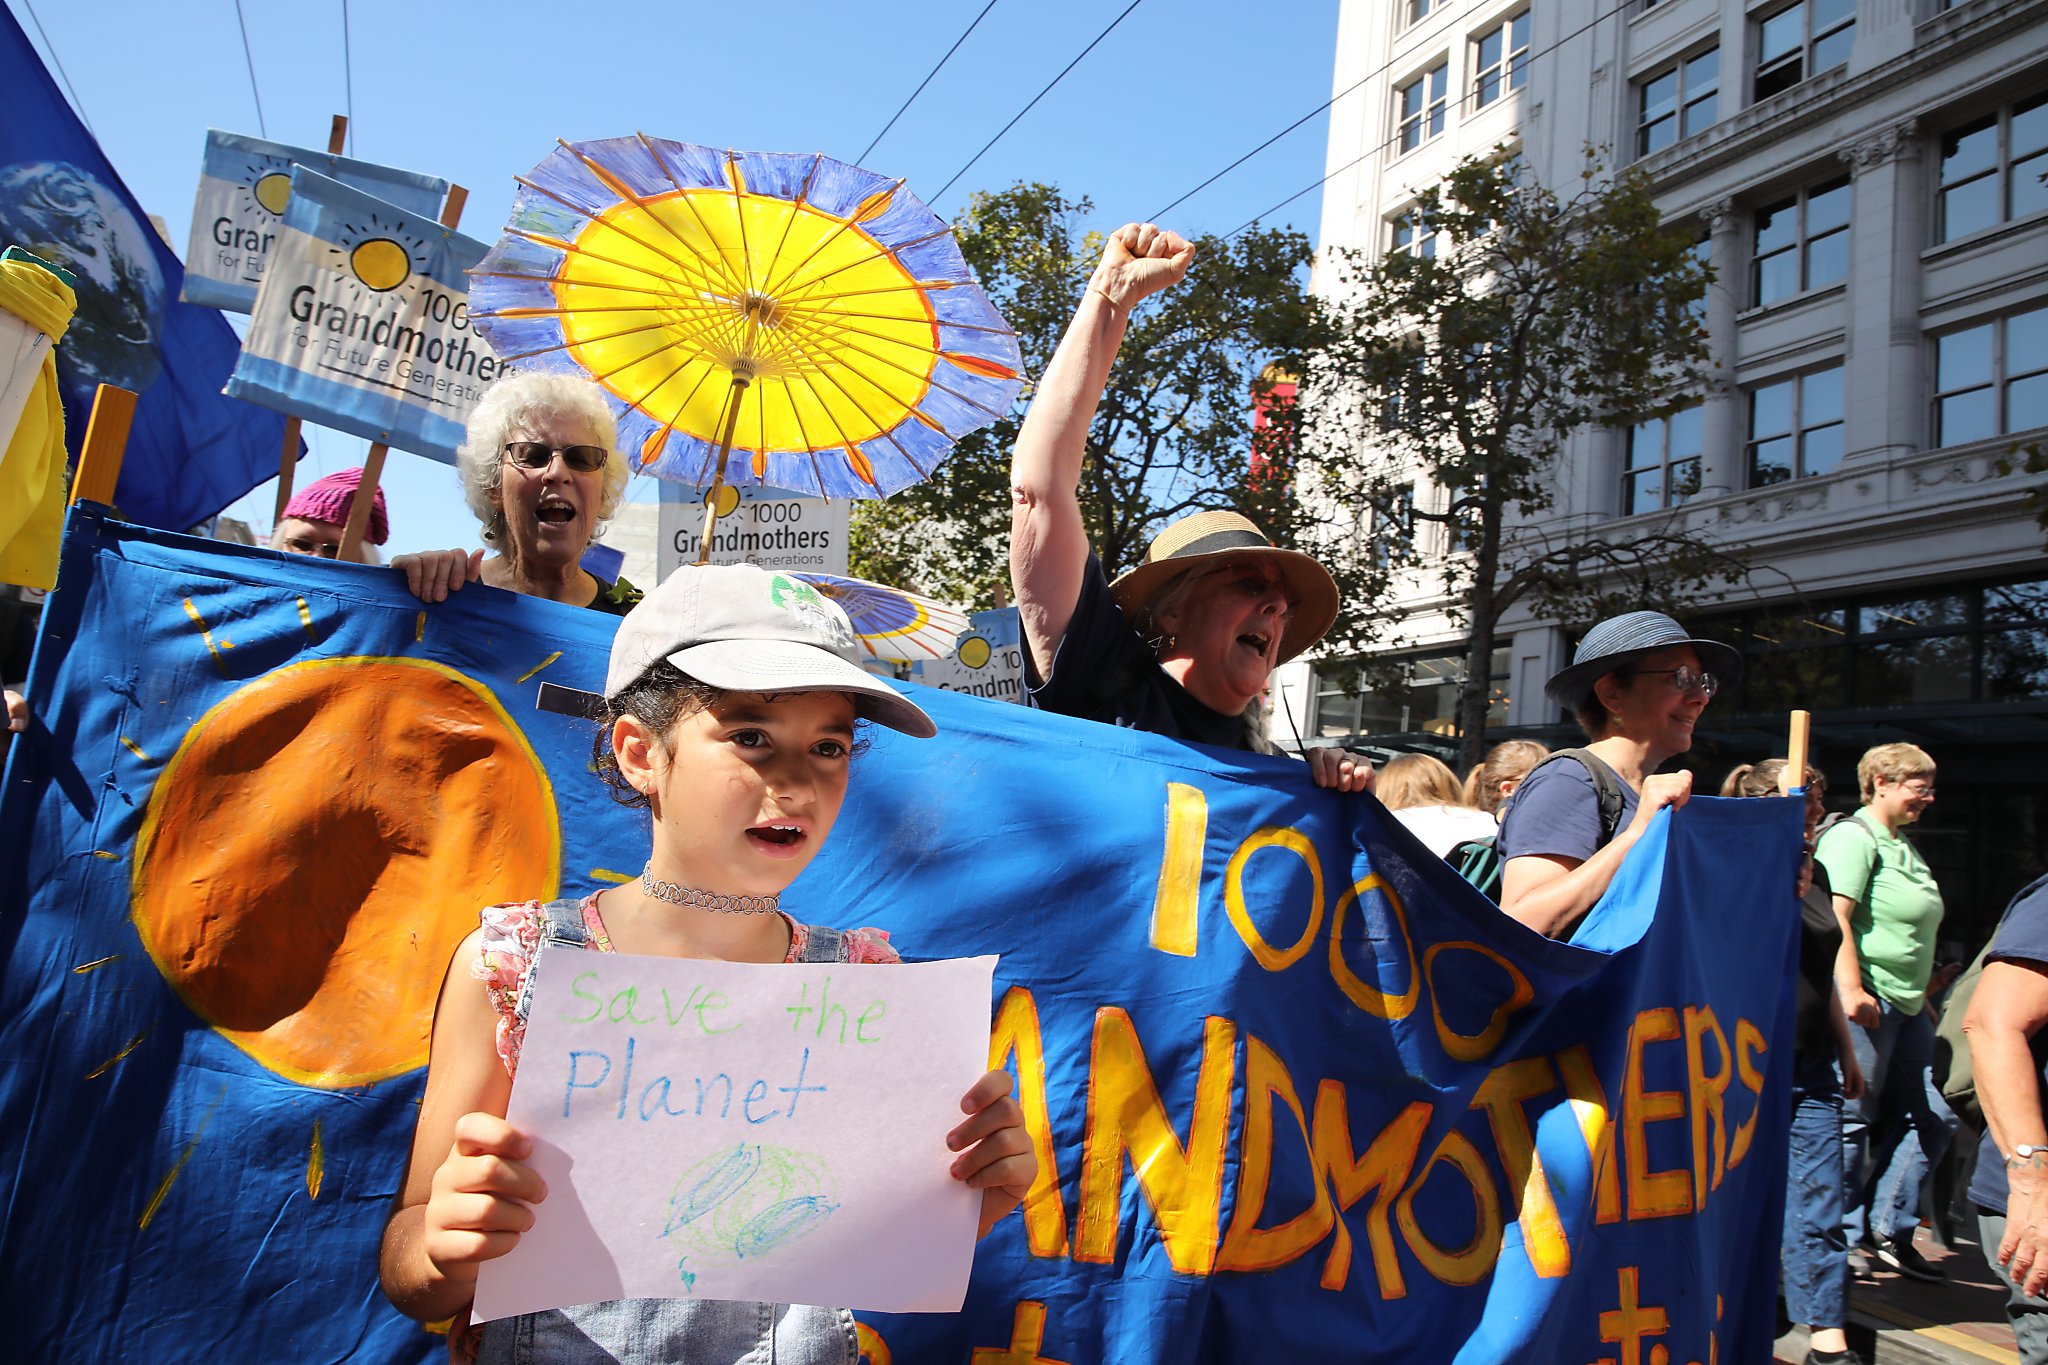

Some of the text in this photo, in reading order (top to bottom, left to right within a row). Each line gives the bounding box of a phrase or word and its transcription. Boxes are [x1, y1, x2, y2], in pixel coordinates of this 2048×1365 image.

[217, 250, 241, 268] for
[289, 326, 319, 350] for
[324, 338, 390, 371] Future
[290, 286, 516, 382] Grandmother
[750, 503, 801, 523] 1000
[674, 525, 829, 554] Grndmothers
[745, 553, 824, 566] Generations
[1149, 782, 1535, 1062] 1000
[560, 971, 887, 1044] Save the
[562, 1037, 827, 1124] Planet
